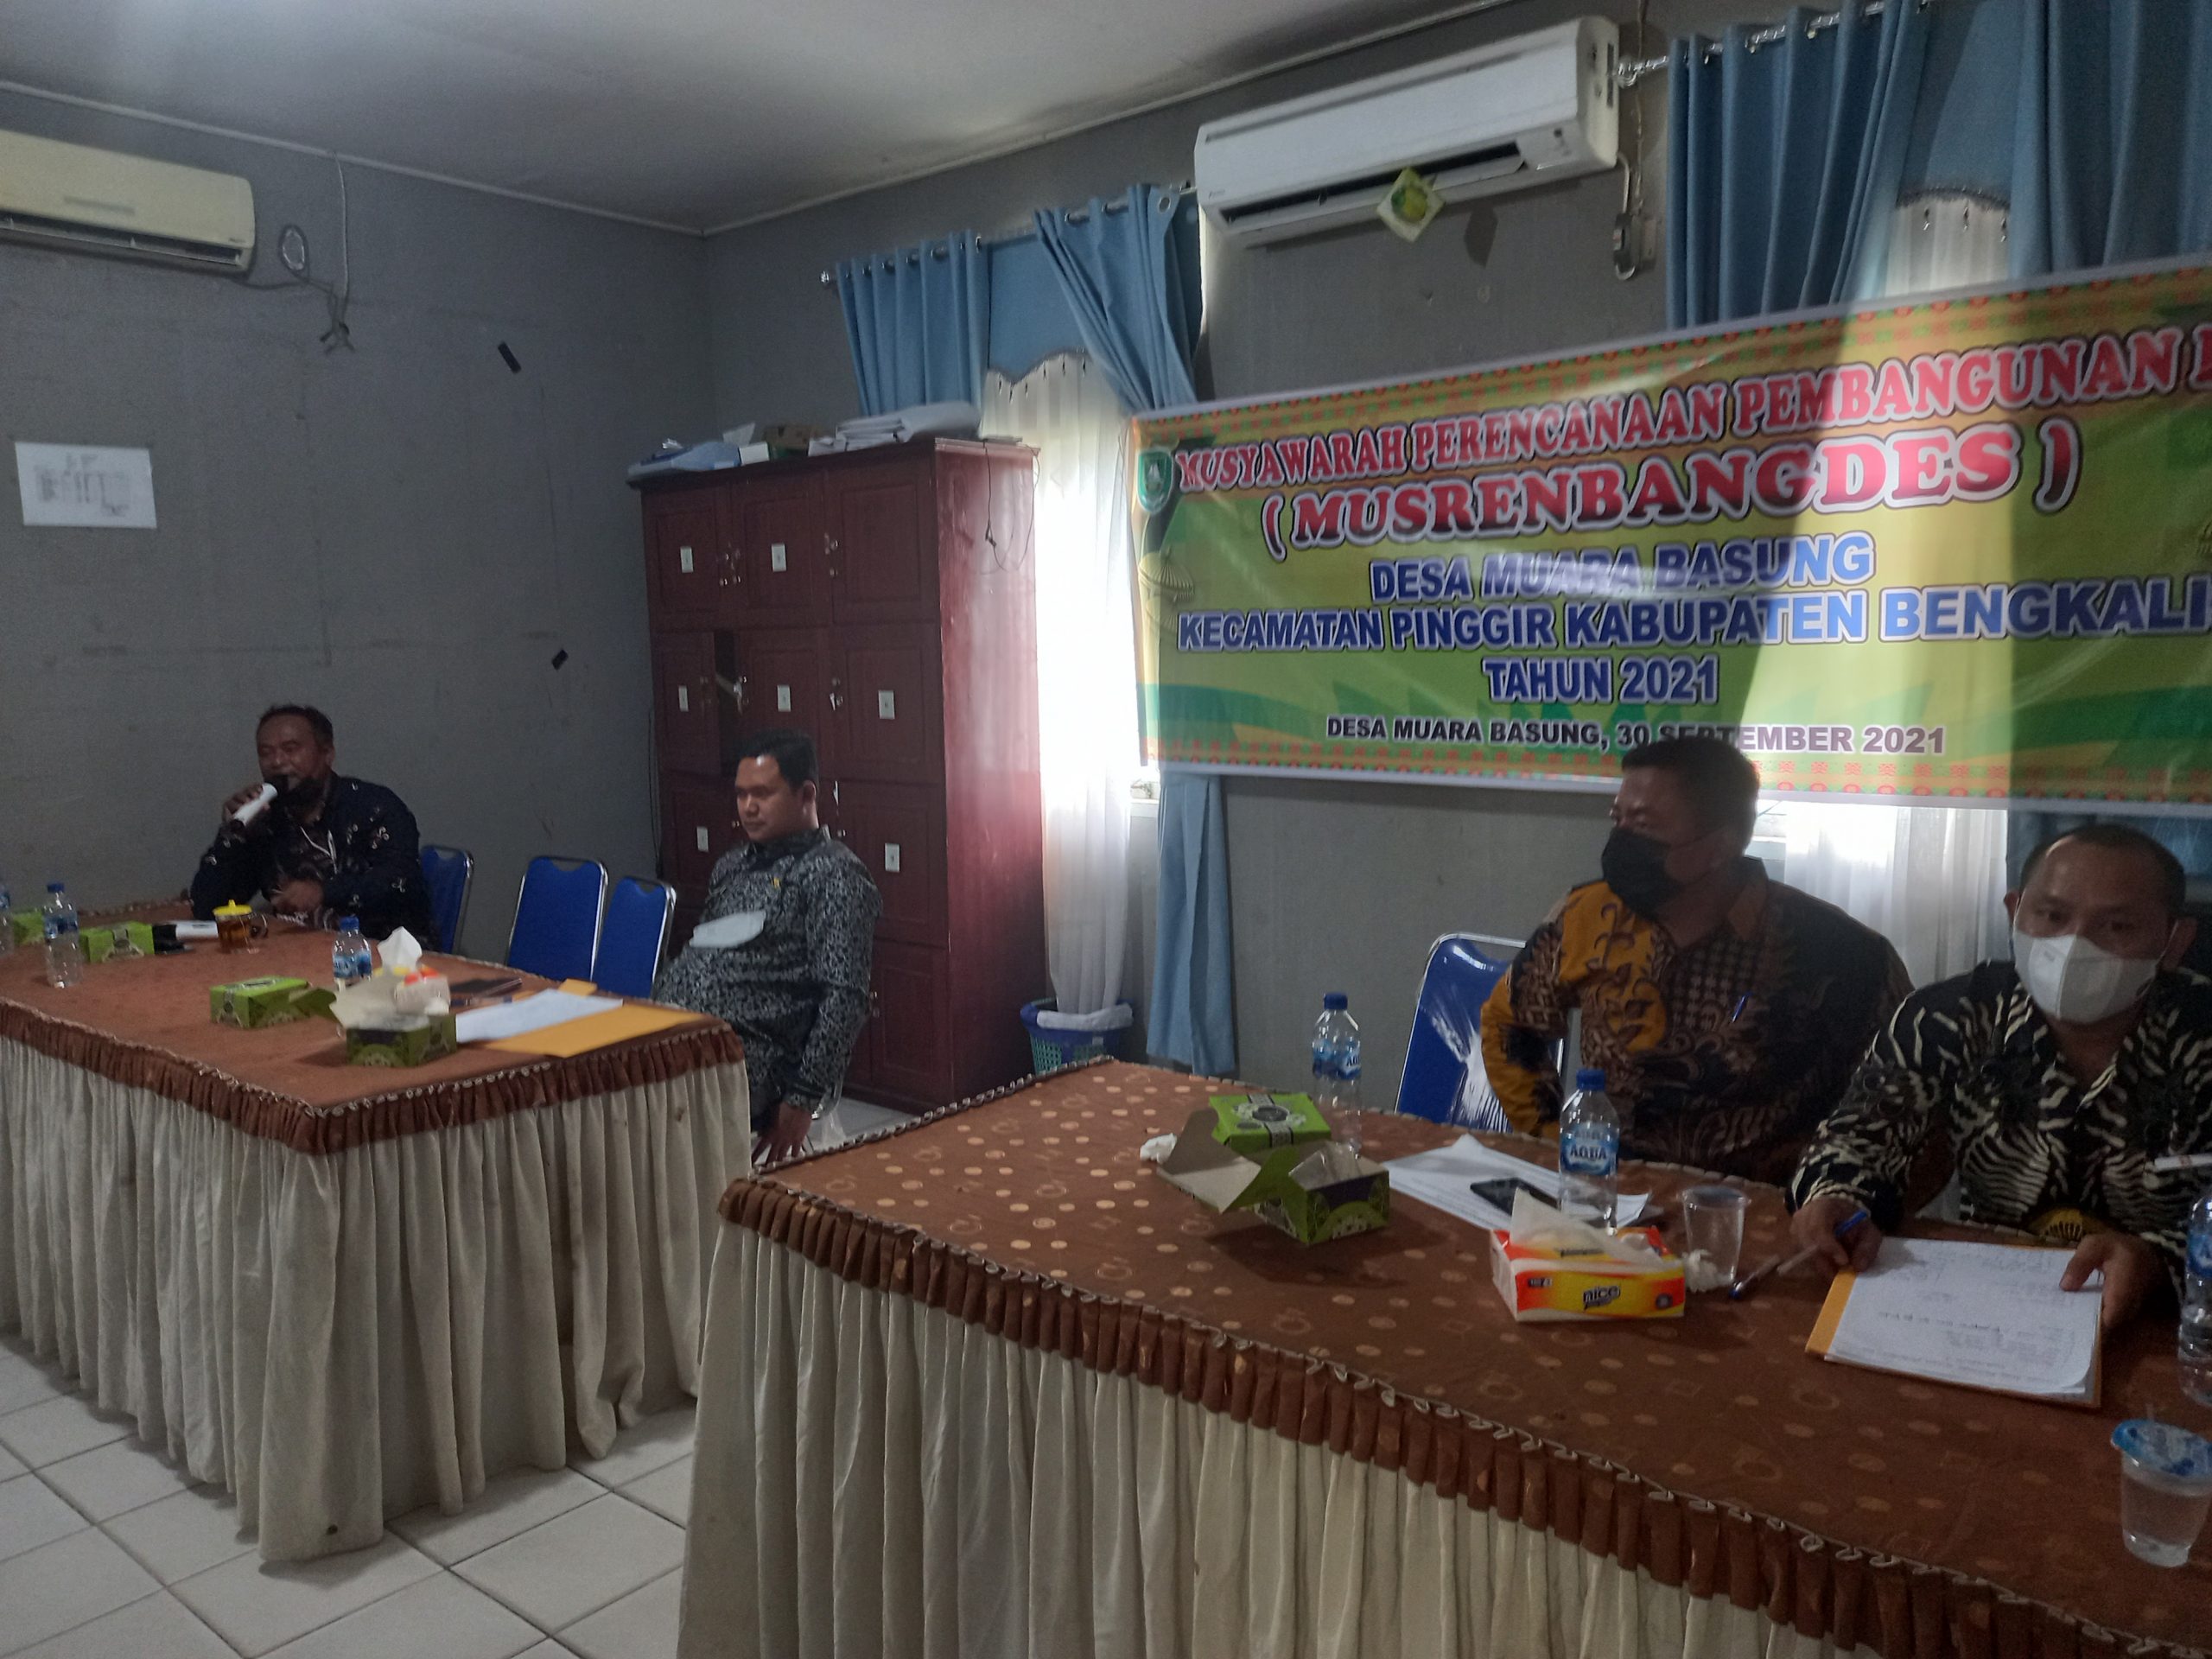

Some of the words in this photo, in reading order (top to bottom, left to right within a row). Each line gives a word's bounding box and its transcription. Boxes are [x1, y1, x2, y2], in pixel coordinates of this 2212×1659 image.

[1176, 424, 1408, 492] MUSYAWARAH
[1410, 383, 1726, 473] PERENCANAAN
[1732, 327, 2183, 437] PEMBANGUNAN
[1370, 556, 1474, 605] DESA
[1483, 545, 1641, 601] MUARA
[1653, 531, 1876, 591] BASUNG
[1177, 607, 1384, 652] KECAMATAN
[1390, 603, 1559, 652] PINGGIR
[1563, 588, 1867, 650] KABUPATEN
[1878, 574, 2212, 643] BENGKALI
[1482, 656, 1614, 704] TAHUN
[1618, 654, 1719, 704] 2021
[1327, 716, 1387, 739] DESA
[1392, 717, 1482, 742] MUARA
[1489, 721, 1611, 751] BASUNG,
[1617, 722, 1650, 749] 30
[1862, 726, 1945, 755] 2021
[1570, 1144, 1608, 1160] AQUA
